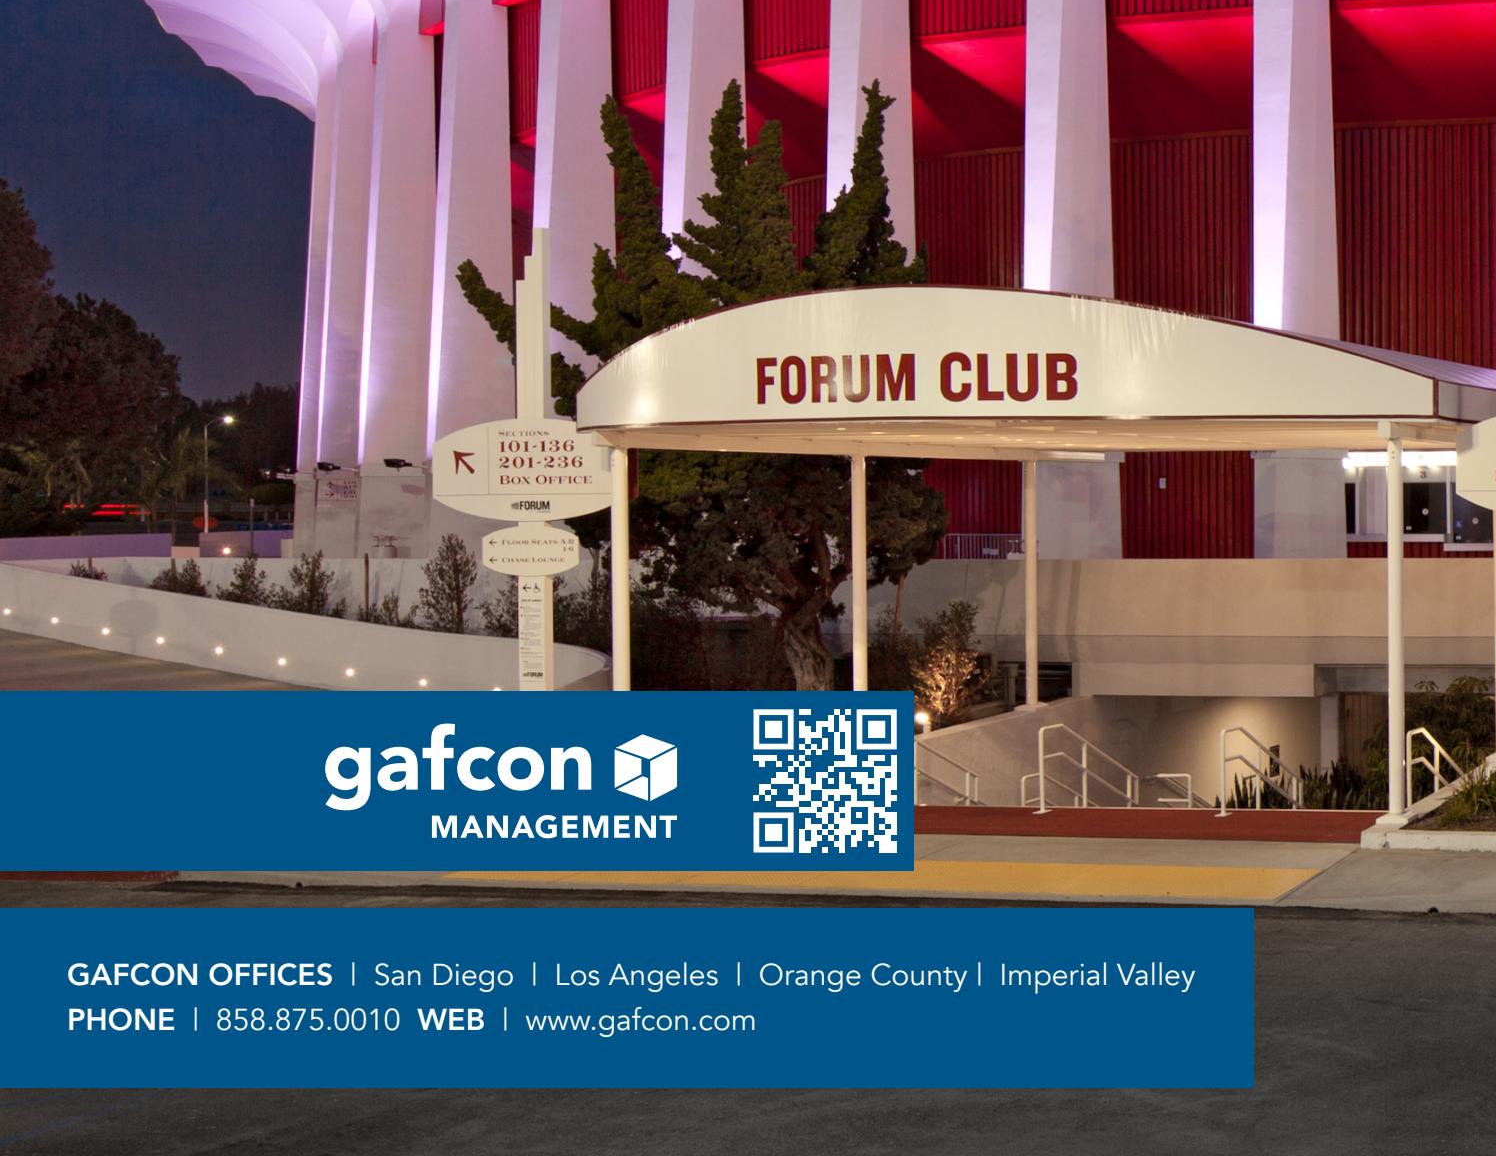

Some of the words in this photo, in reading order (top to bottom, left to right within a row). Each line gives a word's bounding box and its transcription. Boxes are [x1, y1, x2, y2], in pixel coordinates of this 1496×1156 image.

[756, 354, 916, 405] FORUM
[939, 352, 1078, 403] CLUB
[499, 440, 575, 453] 101-136
[499, 456, 583, 468] 201-236
[500, 474, 530, 485] BOX
[535, 474, 593, 485] OFFICE
[519, 500, 550, 510] FORUM
